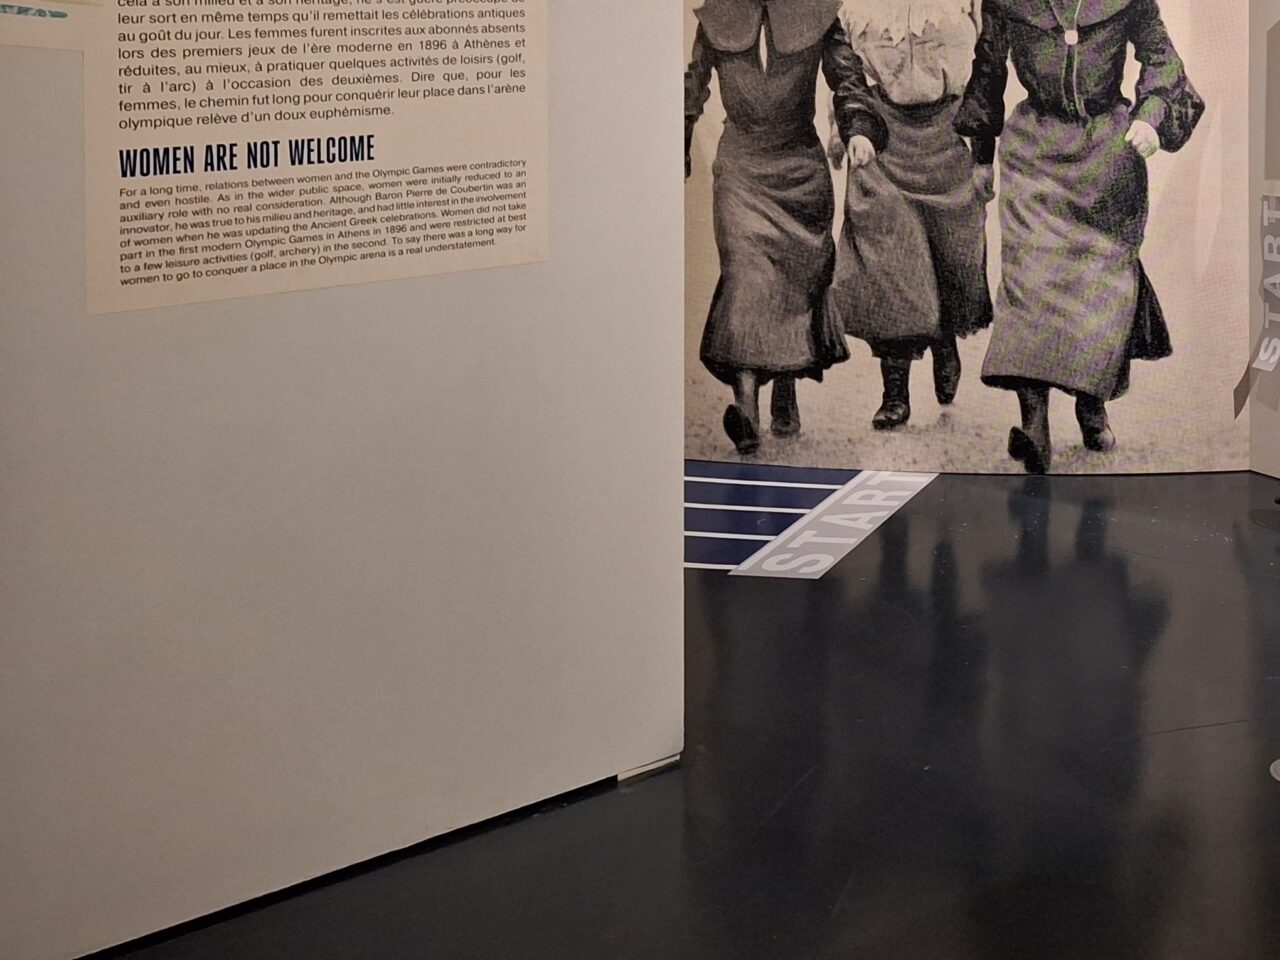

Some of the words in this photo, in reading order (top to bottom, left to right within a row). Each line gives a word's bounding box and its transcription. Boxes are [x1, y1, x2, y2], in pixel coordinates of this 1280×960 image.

[118, 114, 192, 132] olympique
[196, 111, 237, 125] relève
[240, 109, 270, 123] d'un
[274, 108, 306, 121] doux
[309, 104, 393, 122] euphémisme.
[119, 145, 195, 178] WOMEN
[203, 143, 238, 172] ARE
[247, 140, 281, 169] NOT
[289, 134, 375, 164] WELCOME
[119, 187, 137, 197] For
[139, 188, 147, 196] a
[149, 185, 173, 196] long
[175, 183, 202, 193] time,
[204, 179, 249, 191] relations
[251, 176, 294, 187] between
[296, 174, 332, 184] women
[334, 170, 352, 181] and
[354, 169, 370, 179] the
[371, 167, 410, 180] Olympic
[411, 165, 444, 175] Games
[445, 164, 467, 172] were
[469, 158, 526, 171] contradictory
[119, 198, 140, 210] and
[144, 198, 170, 208] even
[174, 193, 212, 205] hostile.
[216, 192, 230, 202] As
[234, 190, 243, 200] in
[247, 189, 264, 199] the
[267, 187, 295, 198] wider
[298, 184, 328, 197] public
[332, 183, 364, 194] space,
[367, 180, 402, 189] women
[405, 177, 428, 186] were
[430, 173, 462, 184] initially
[464, 170, 500, 181] reduced
[503, 169, 512, 178] to
[761, 472, 929, 574] START
